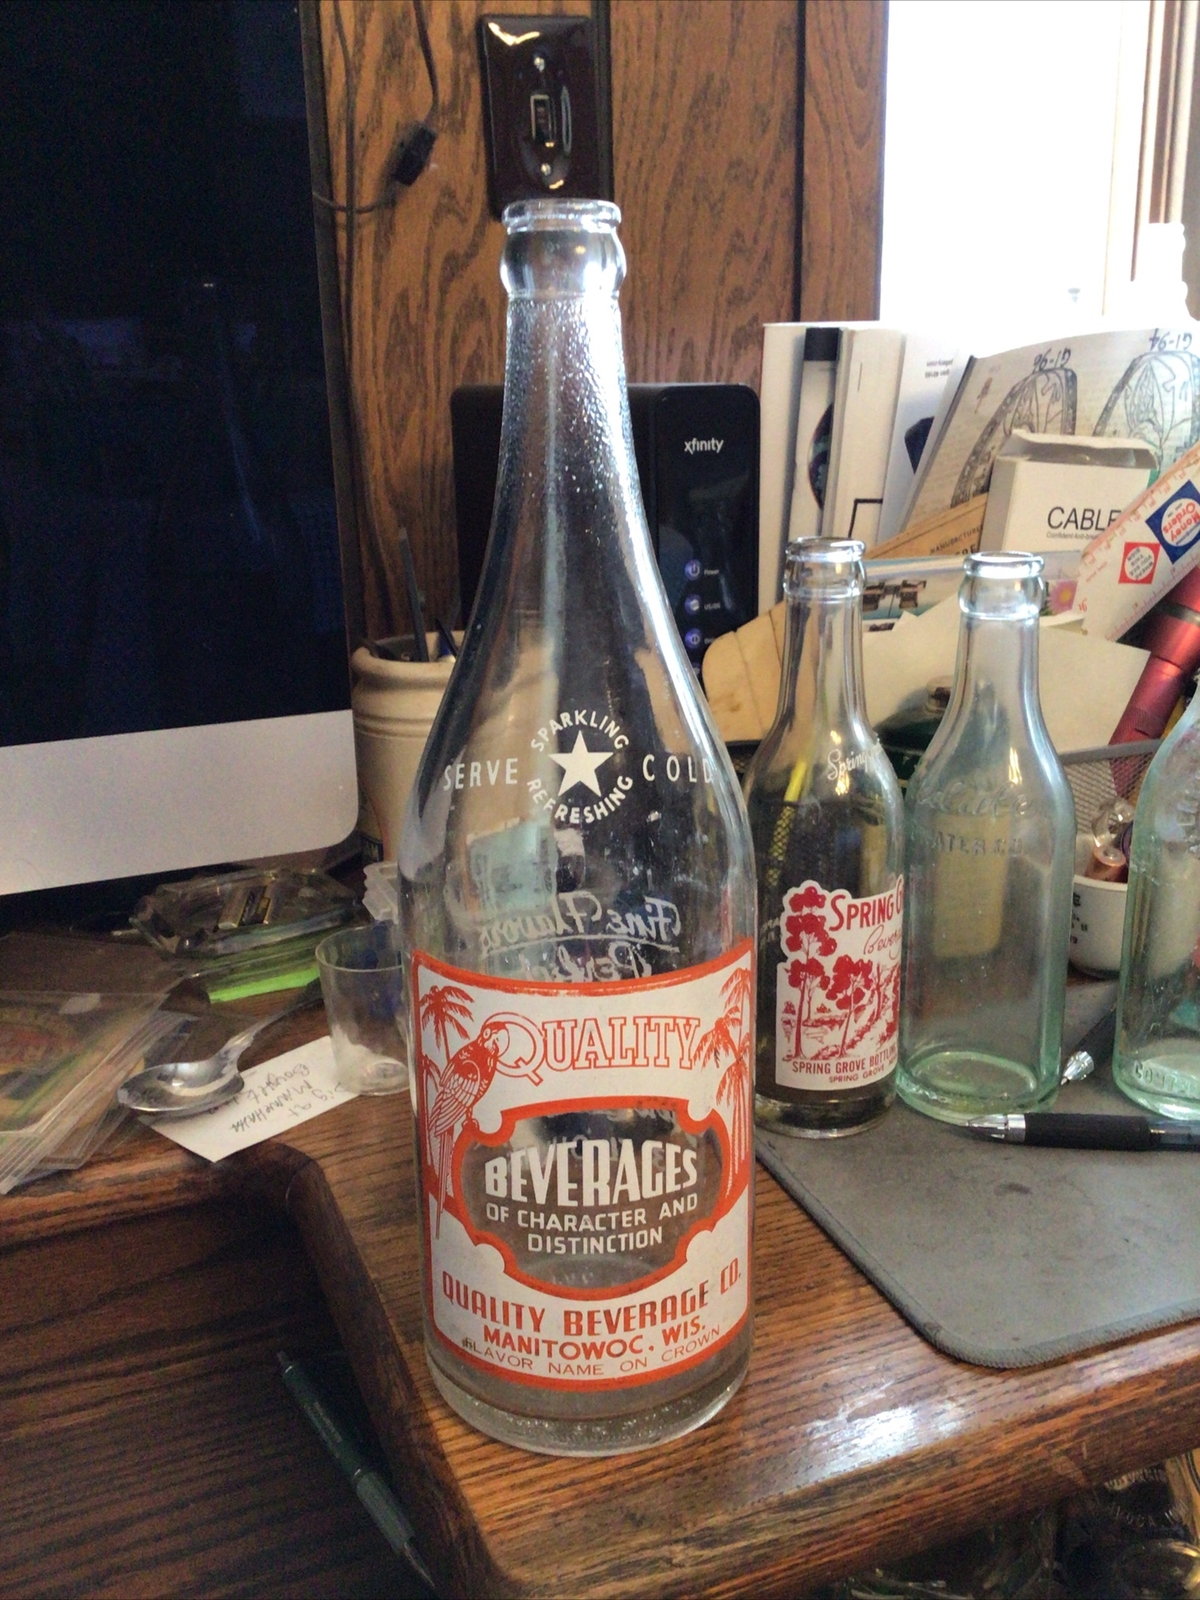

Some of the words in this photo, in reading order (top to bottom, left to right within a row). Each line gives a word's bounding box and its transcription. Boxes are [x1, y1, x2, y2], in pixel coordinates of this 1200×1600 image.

[684, 437, 724, 455] xfinity
[530, 709, 630, 752] SPARKLING
[443, 758, 519, 791] SERVE
[642, 754, 714, 784] COLD
[526, 774, 634, 825] REFRESHING
[829, 893, 894, 932] SPRING
[482, 1011, 701, 1087] QUALITY
[792, 1061, 832, 1075] SPRING
[835, 1057, 867, 1075] GROVE
[484, 1138, 699, 1208] BEVERAGES
[486, 1202, 511, 1223] OF
[517, 1207, 648, 1233] CHARACTER
[658, 1191, 699, 1221] AND
[527, 1226, 664, 1255] DISTINCTION
[442, 1270, 546, 1334] QUALITY
[562, 1279, 710, 1337] BEVERAGE
[720, 1257, 742, 1295] CO.
[548, 1361, 605, 1376] NAME
[619, 1356, 648, 1373] ON
[661, 1324, 721, 1363] CROWN
[661, 1315, 707, 1348] WIS.
